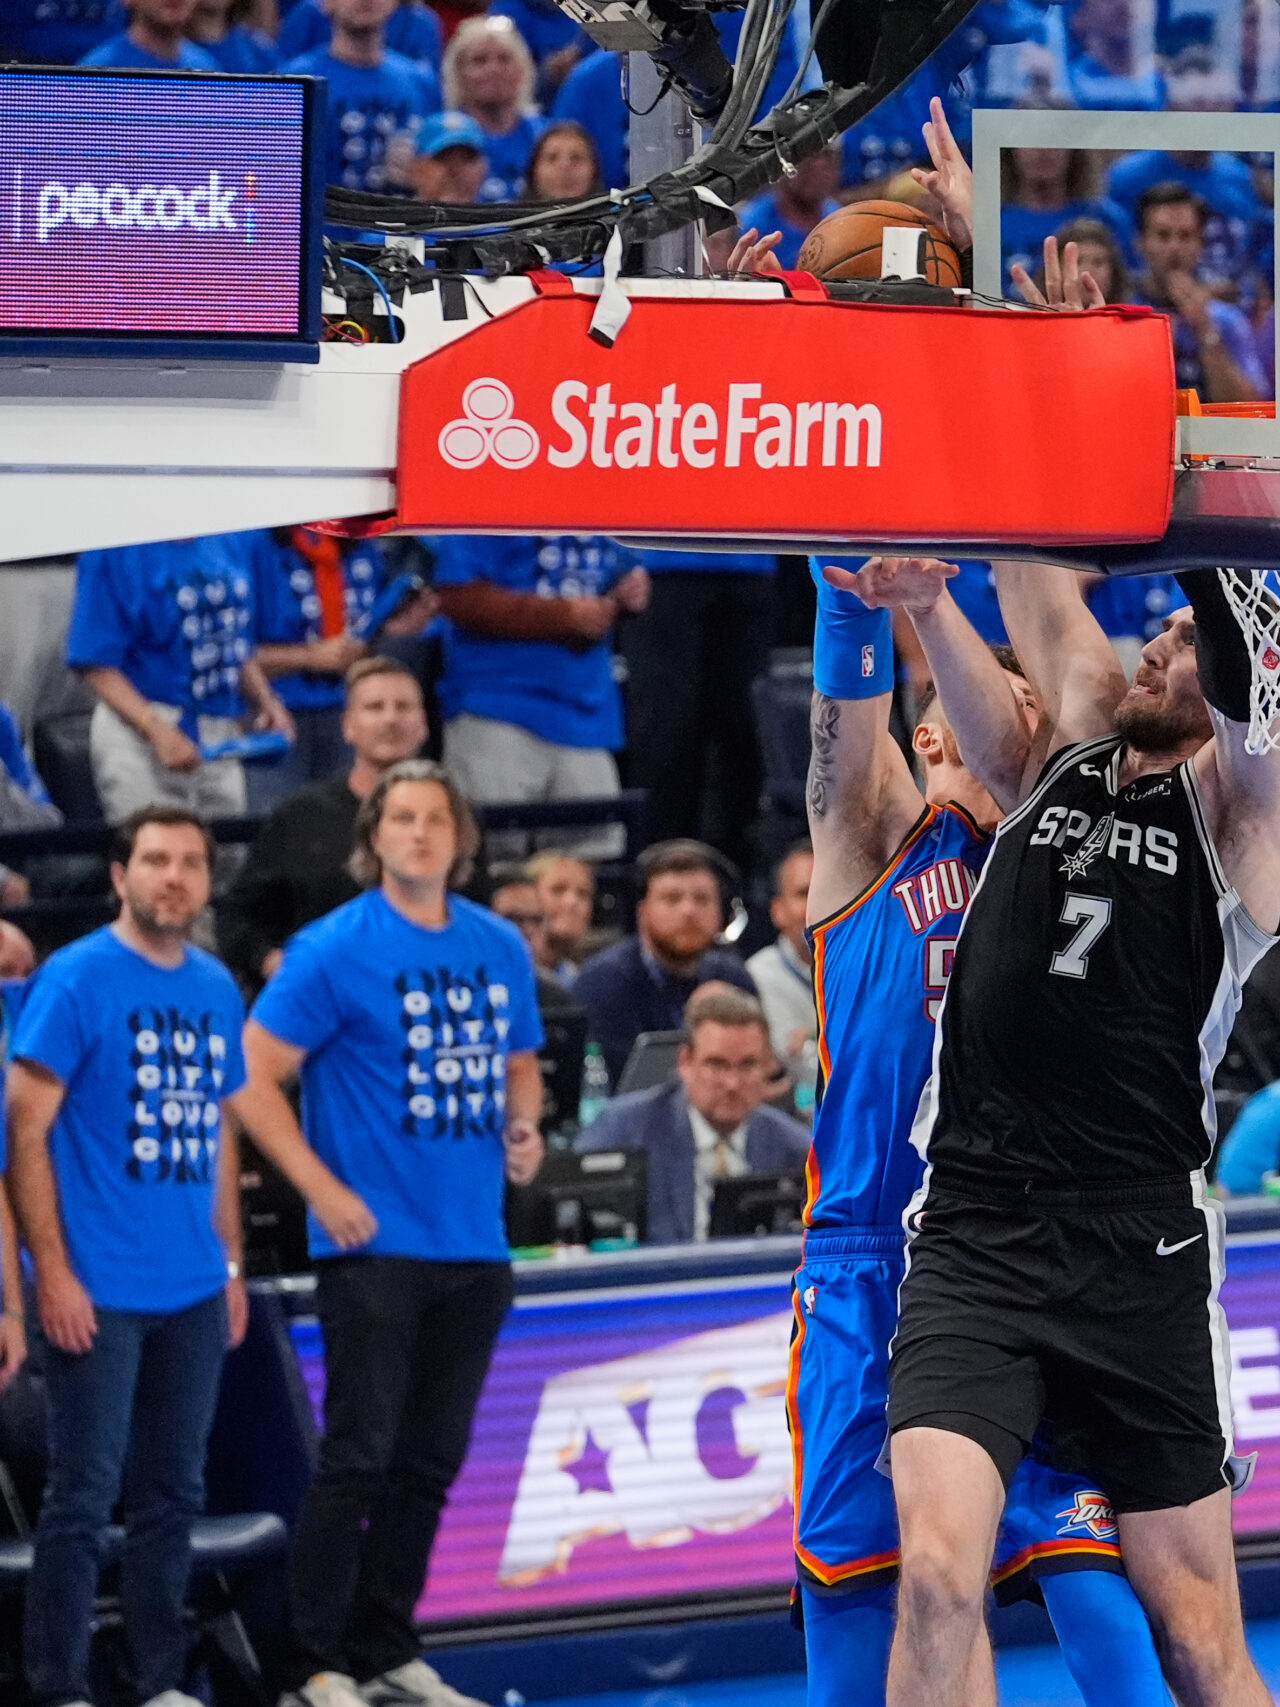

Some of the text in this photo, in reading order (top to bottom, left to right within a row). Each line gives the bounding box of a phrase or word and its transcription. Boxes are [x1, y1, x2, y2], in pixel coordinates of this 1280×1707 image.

[39, 169, 238, 243] peacock
[1029, 806, 1179, 881] SPURS
[892, 857, 978, 936] THUN
[1048, 891, 1113, 980] 7
[403, 984, 509, 1016] OUR
[136, 1030, 226, 1060] OUR
[498, 1310, 795, 1587] AG
